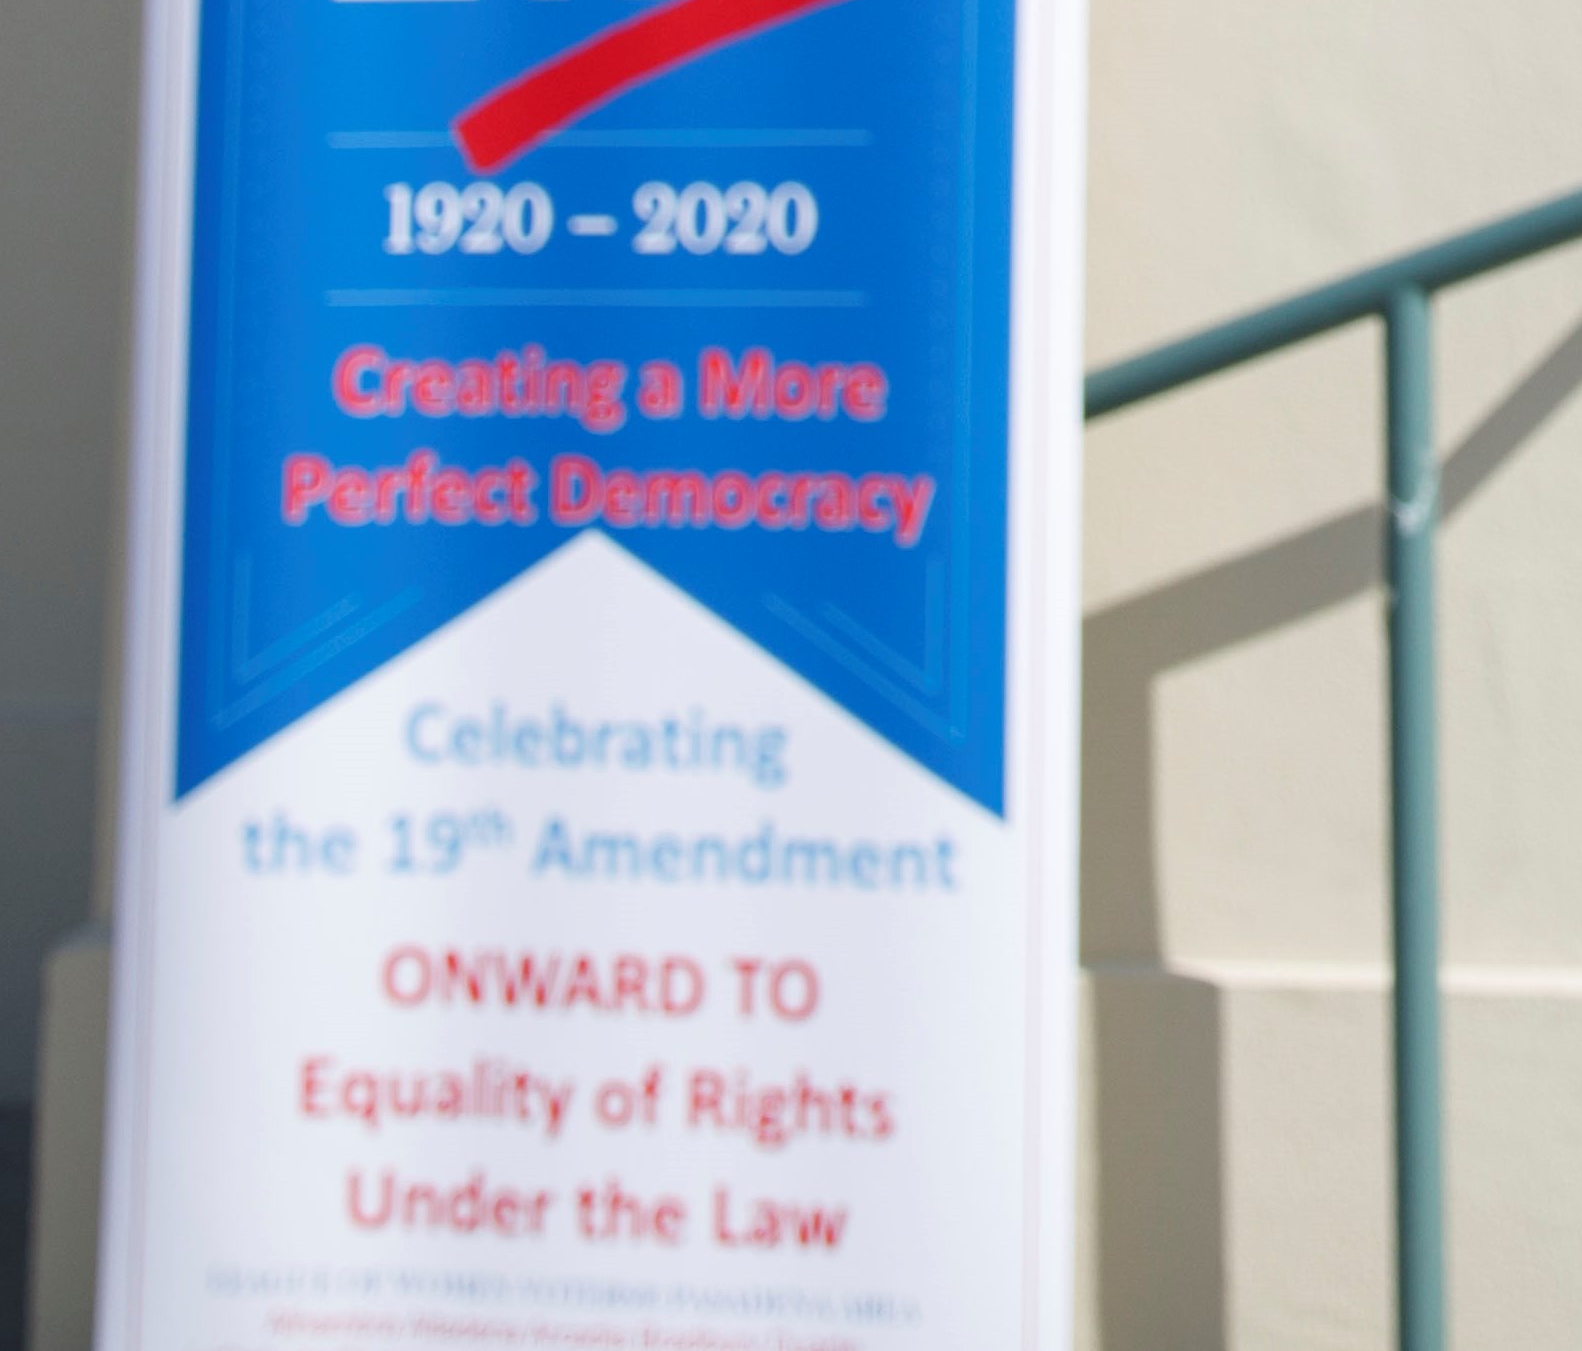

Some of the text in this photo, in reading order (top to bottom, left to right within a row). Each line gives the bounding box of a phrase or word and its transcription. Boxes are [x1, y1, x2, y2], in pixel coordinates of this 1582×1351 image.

[382, 181, 555, 256] 1920
[631, 182, 819, 256] 2020
[331, 343, 888, 433] Creating a More
[281, 447, 936, 547] Perfect Democracy
[402, 700, 788, 783] Celebrating
[239, 811, 358, 877] the
[529, 813, 958, 893] Amendment
[381, 944, 822, 1024] ONWARD TO
[299, 1056, 897, 1150] Equality of Rights
[346, 1171, 851, 1253] Under the Law
